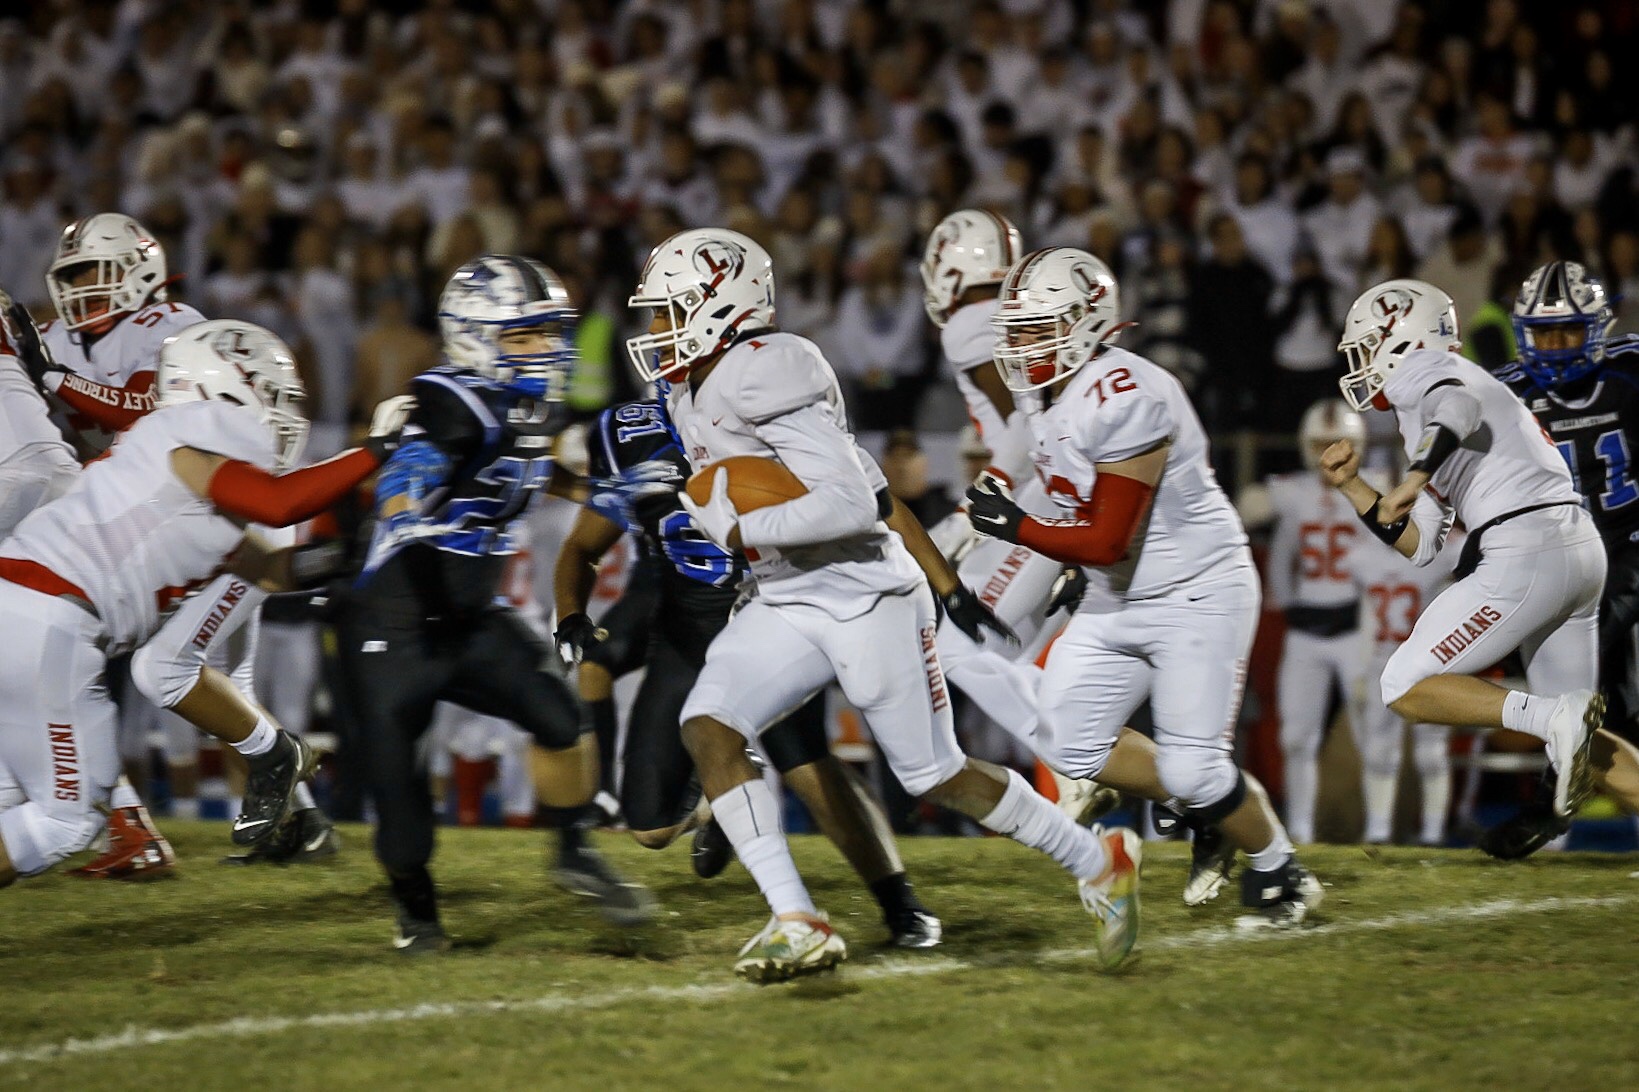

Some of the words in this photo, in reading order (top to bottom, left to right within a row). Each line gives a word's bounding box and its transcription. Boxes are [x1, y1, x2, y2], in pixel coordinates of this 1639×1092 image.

[698, 248, 730, 274] L
[1377, 296, 1399, 316] L
[63, 373, 120, 406] STRONG
[1084, 367, 1138, 408] 72
[615, 404, 667, 443] 61
[980, 546, 1031, 607] NDIANS
[192, 581, 246, 649] INDIANS
[1430, 605, 1502, 665] INDIANS
[47, 722, 80, 802] INDIANS
